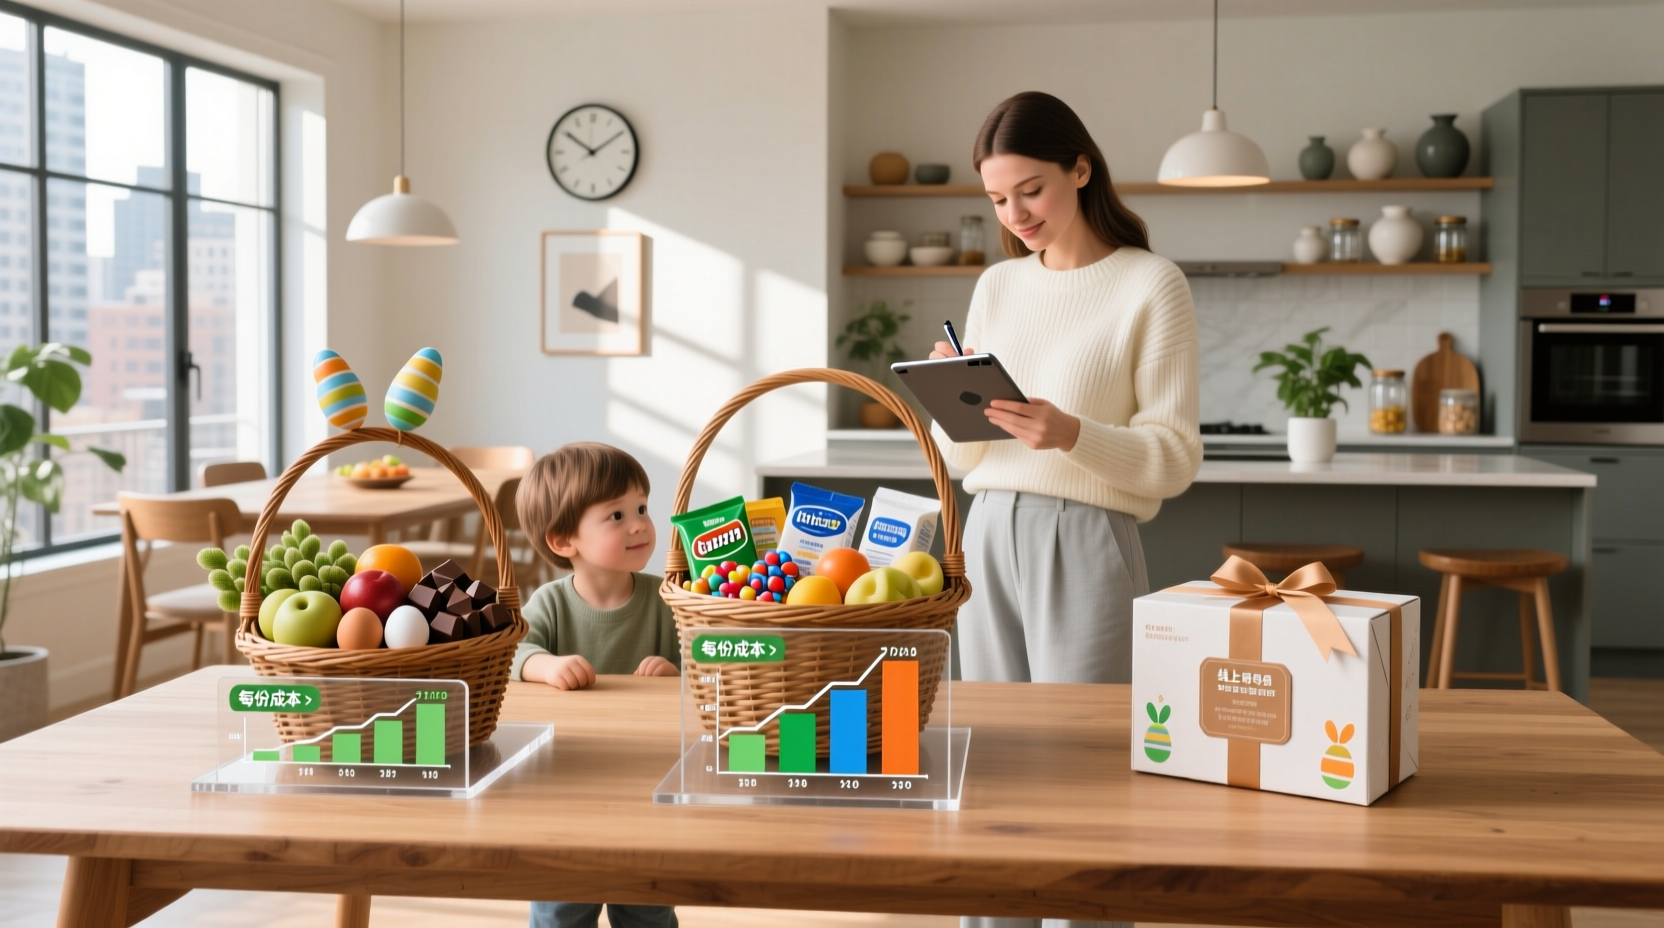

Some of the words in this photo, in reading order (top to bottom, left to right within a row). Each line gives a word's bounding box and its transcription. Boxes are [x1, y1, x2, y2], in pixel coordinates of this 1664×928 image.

[701, 639, 766, 659] 每份成本
[238, 689, 302, 708] 每份成本
